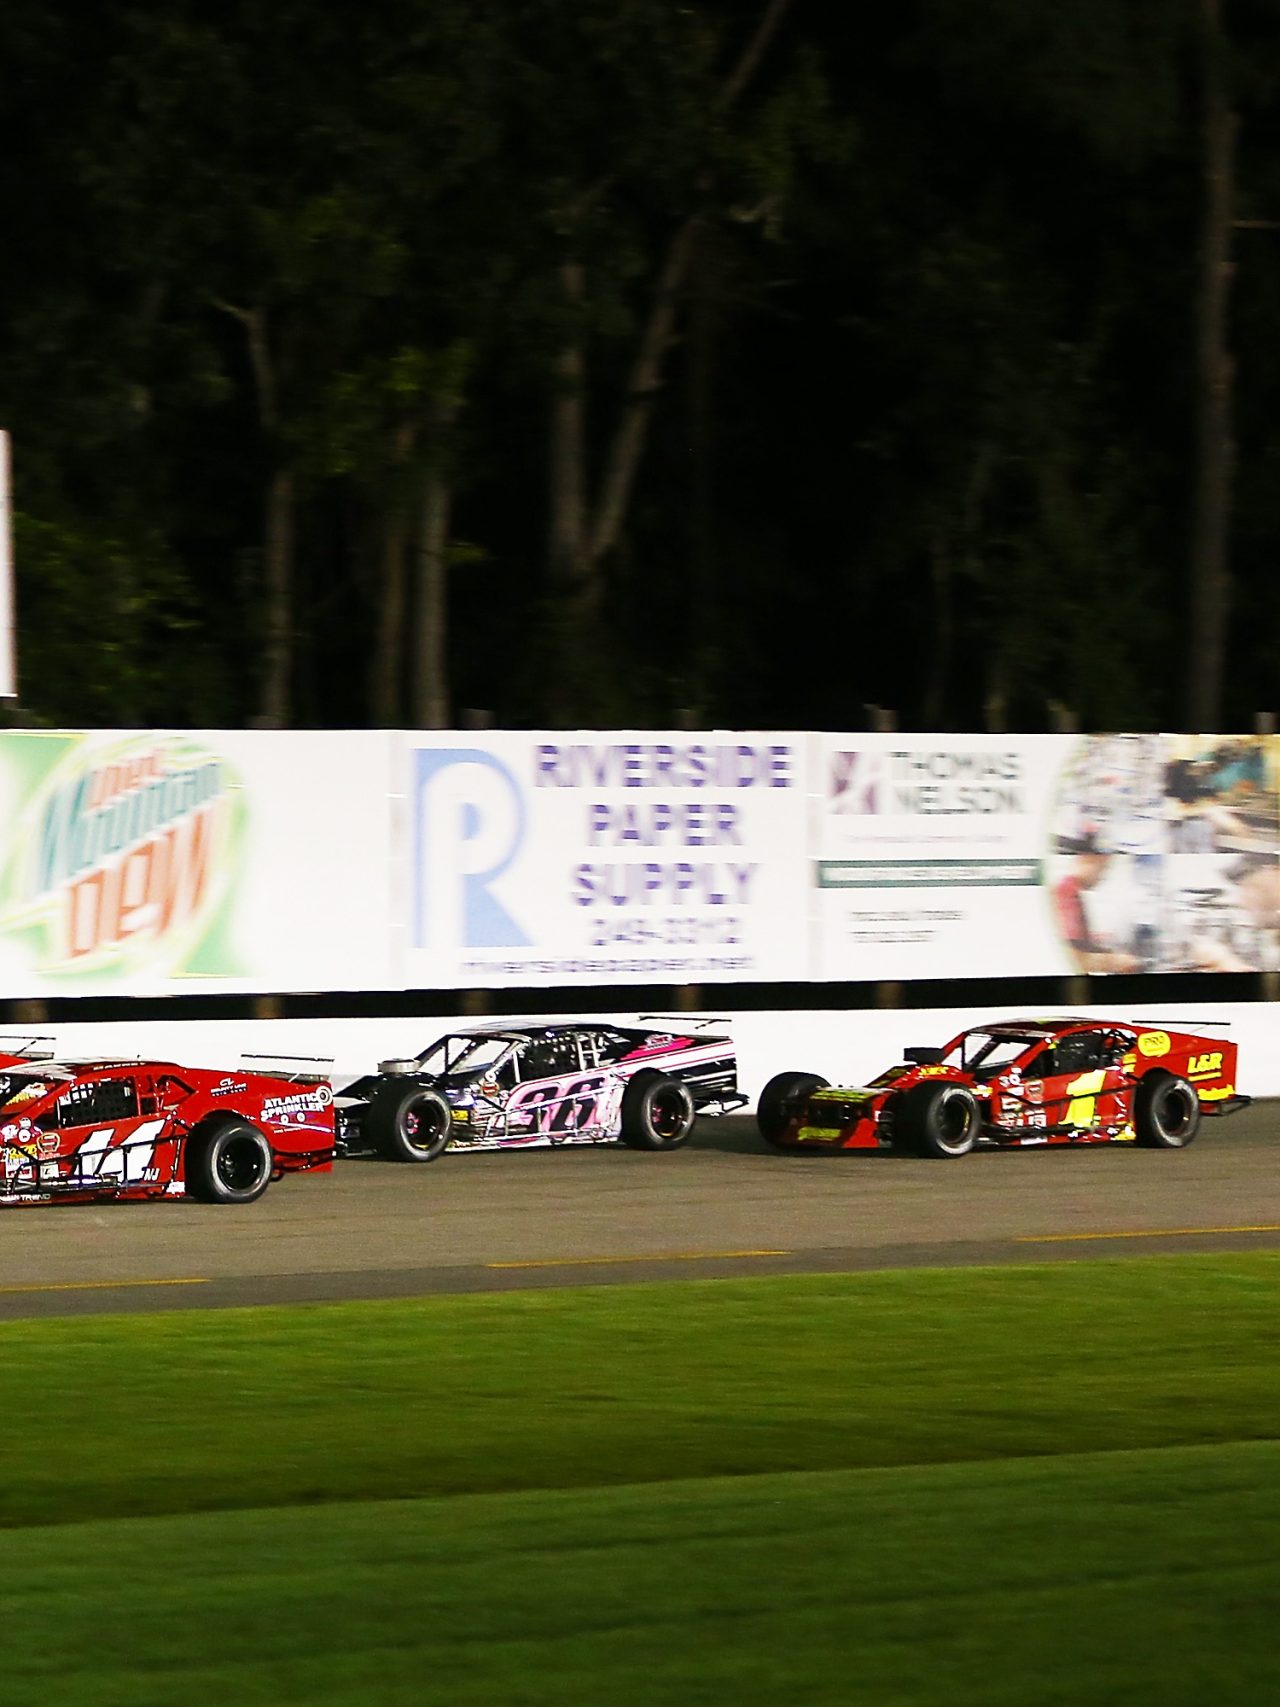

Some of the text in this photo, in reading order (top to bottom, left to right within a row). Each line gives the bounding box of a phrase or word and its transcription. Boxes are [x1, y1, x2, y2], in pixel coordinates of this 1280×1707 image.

[532, 745, 794, 787] RIVERSIDE
[891, 751, 1022, 781] THOMAS
[896, 786, 1022, 816] NELSON
[586, 804, 746, 846] PAPER
[570, 862, 760, 906] SUPPLY
[261, 1101, 325, 1122] SPRINKLER
[264, 1092, 321, 1110] ATLANTIC
[1057, 1069, 1106, 1127] 1
[73, 1119, 165, 1182] 14
[144, 1168, 160, 1181] NJ
